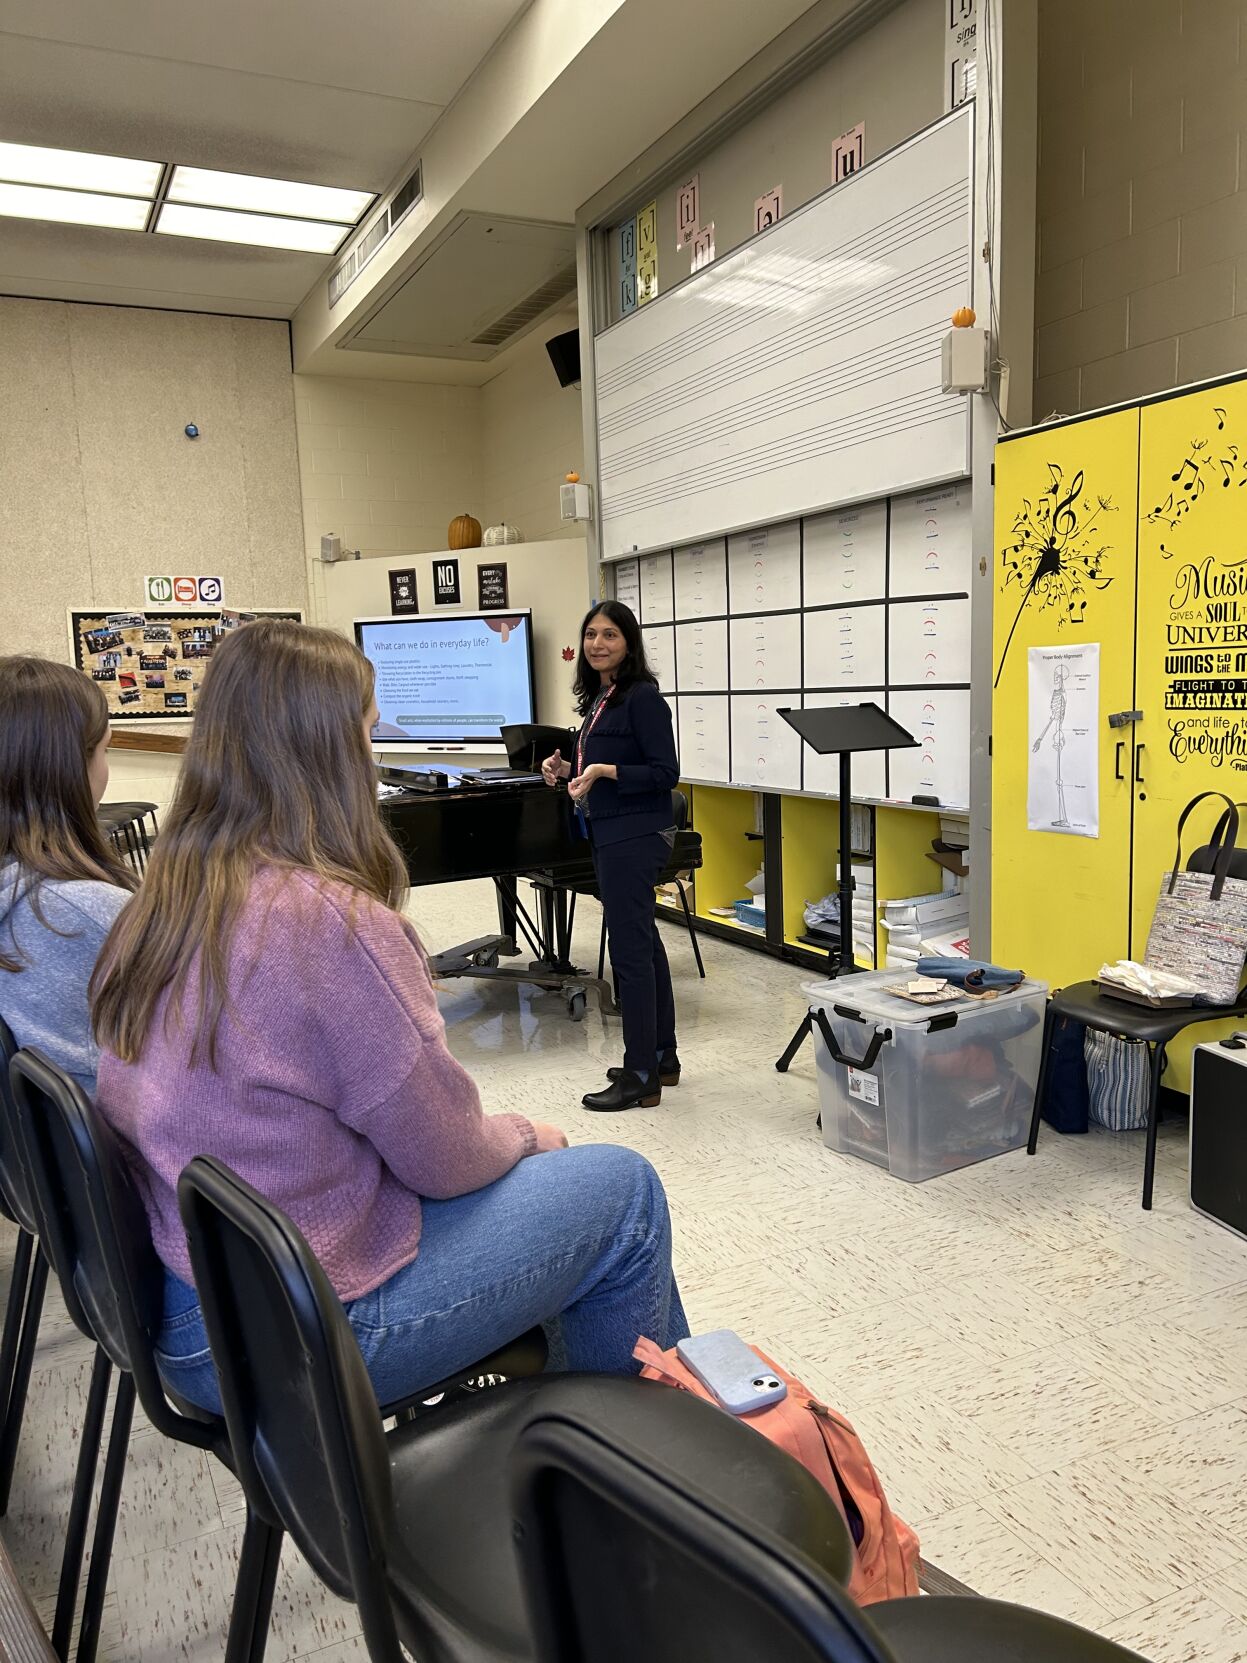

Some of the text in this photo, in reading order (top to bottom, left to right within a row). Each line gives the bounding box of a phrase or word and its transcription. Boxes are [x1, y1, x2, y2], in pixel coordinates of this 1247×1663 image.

[438, 565, 454, 586] NO
[1170, 610, 1194, 621] GIVES
[1196, 610, 1203, 619] A
[1206, 601, 1241, 624] SOUL
[374, 641, 392, 650] What
[420, 640, 429, 648] do
[431, 640, 437, 648] in
[440, 639, 471, 649] everyday
[473, 637, 489, 646] life?
[1175, 681, 1214, 691] FLIGHT
[1220, 680, 1235, 690] TO
[1187, 716, 1210, 729] and
[1213, 716, 1230, 729] life
